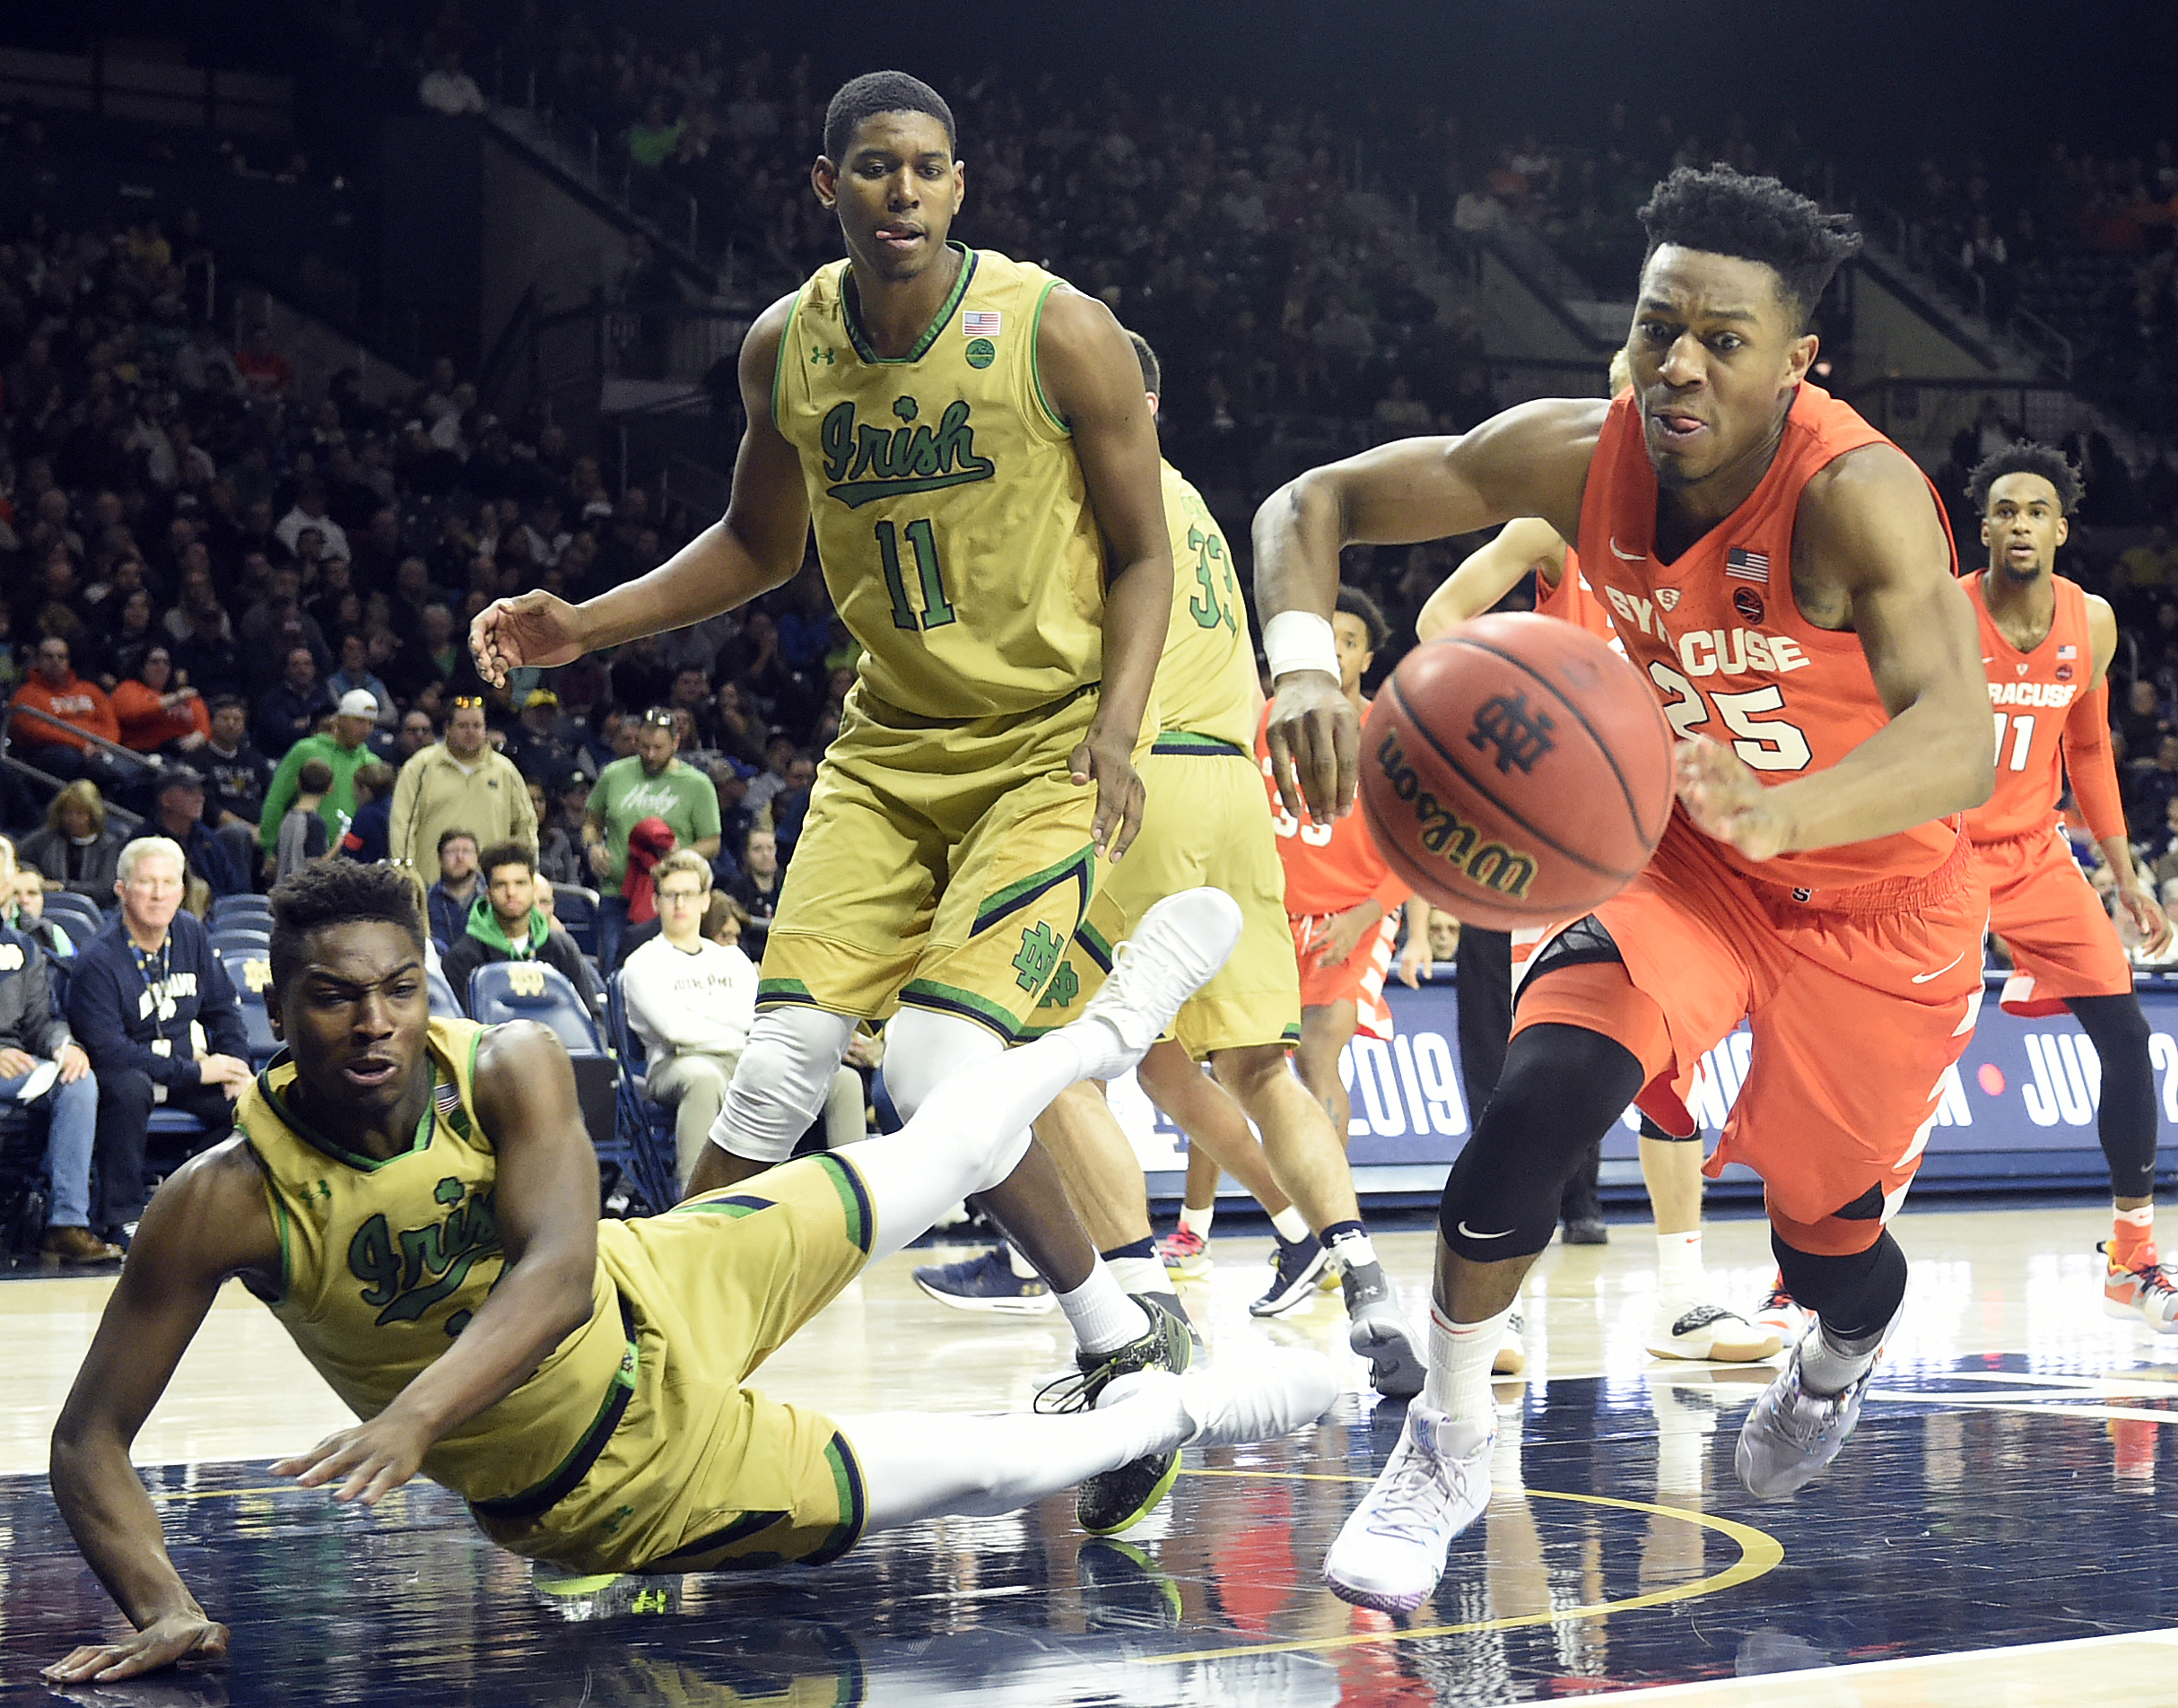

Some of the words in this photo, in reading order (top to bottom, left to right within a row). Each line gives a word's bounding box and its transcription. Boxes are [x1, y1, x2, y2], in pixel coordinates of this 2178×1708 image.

[822, 400, 996, 489] Irish
[875, 518, 956, 632] 11
[1605, 585, 1811, 676] SYCUSE
[1647, 658, 1813, 771] 25
[1988, 682, 2078, 708] RACUSE
[1378, 728, 1538, 899] Wilson
[348, 1190, 504, 1307] Iris
